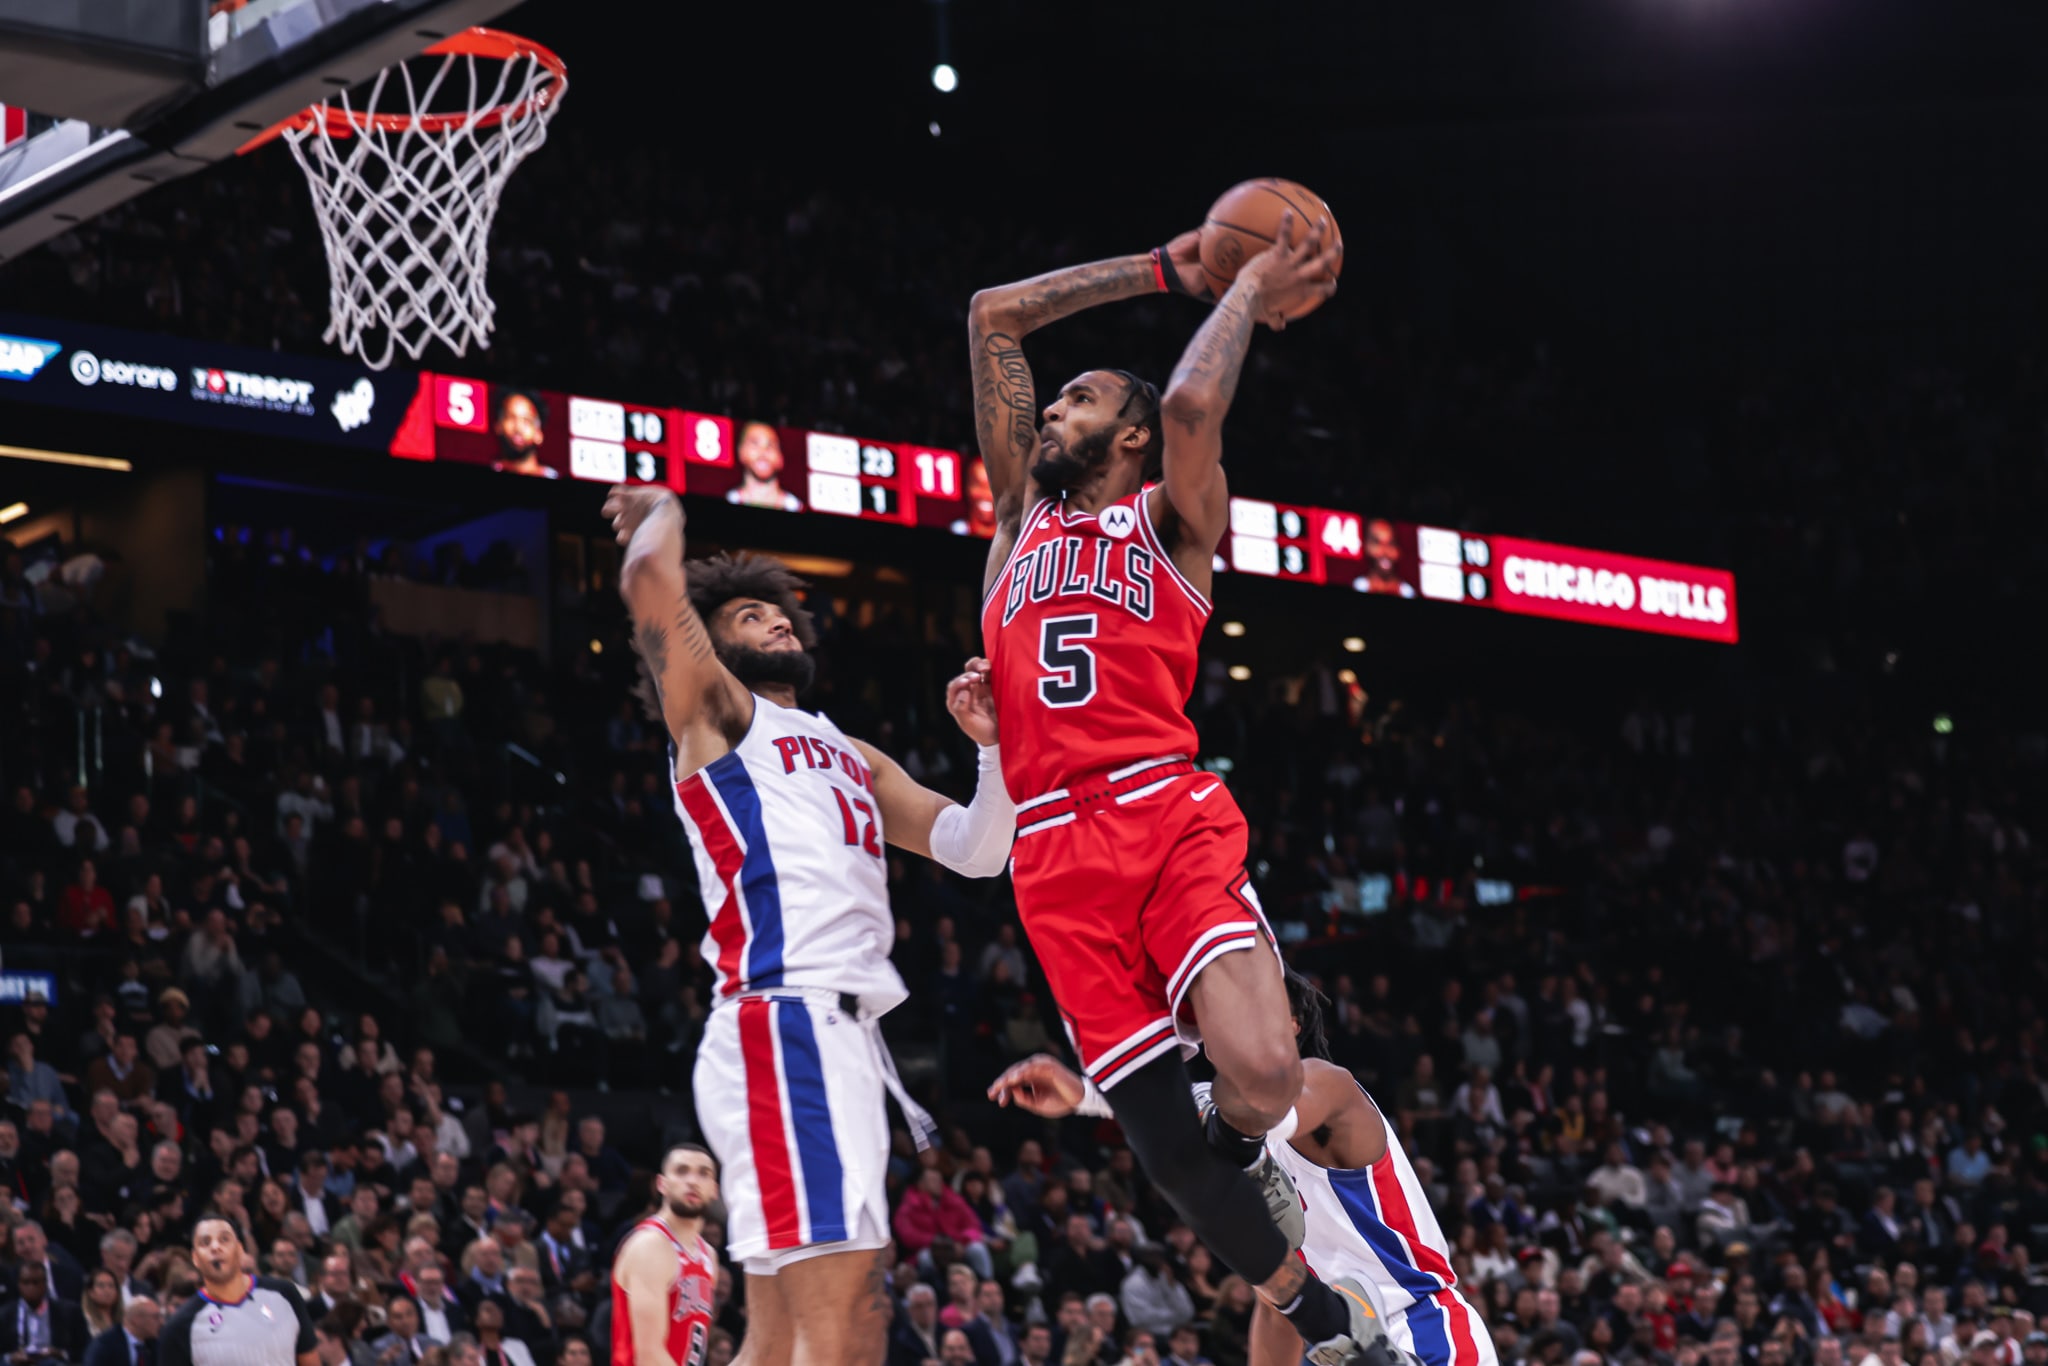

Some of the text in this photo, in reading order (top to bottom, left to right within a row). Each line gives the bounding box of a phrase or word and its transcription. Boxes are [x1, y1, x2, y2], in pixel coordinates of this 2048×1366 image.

[101, 360, 177, 391] sorare
[448, 382, 475, 425] 5
[629, 411, 662, 444] 10
[695, 419, 721, 461] 8
[635, 451, 656, 482] 3
[862, 445, 894, 478] 23
[915, 453, 954, 495] 11
[870, 485, 886, 514] 1
[1322, 515, 1362, 556] 44
[1284, 545, 1303, 575] 3
[1002, 537, 1154, 627] BULLS
[1503, 555, 1636, 610] CHICAGO
[1638, 575, 1728, 624] BULLS
[1038, 613, 1098, 709] 5
[831, 785, 882, 860] 12
